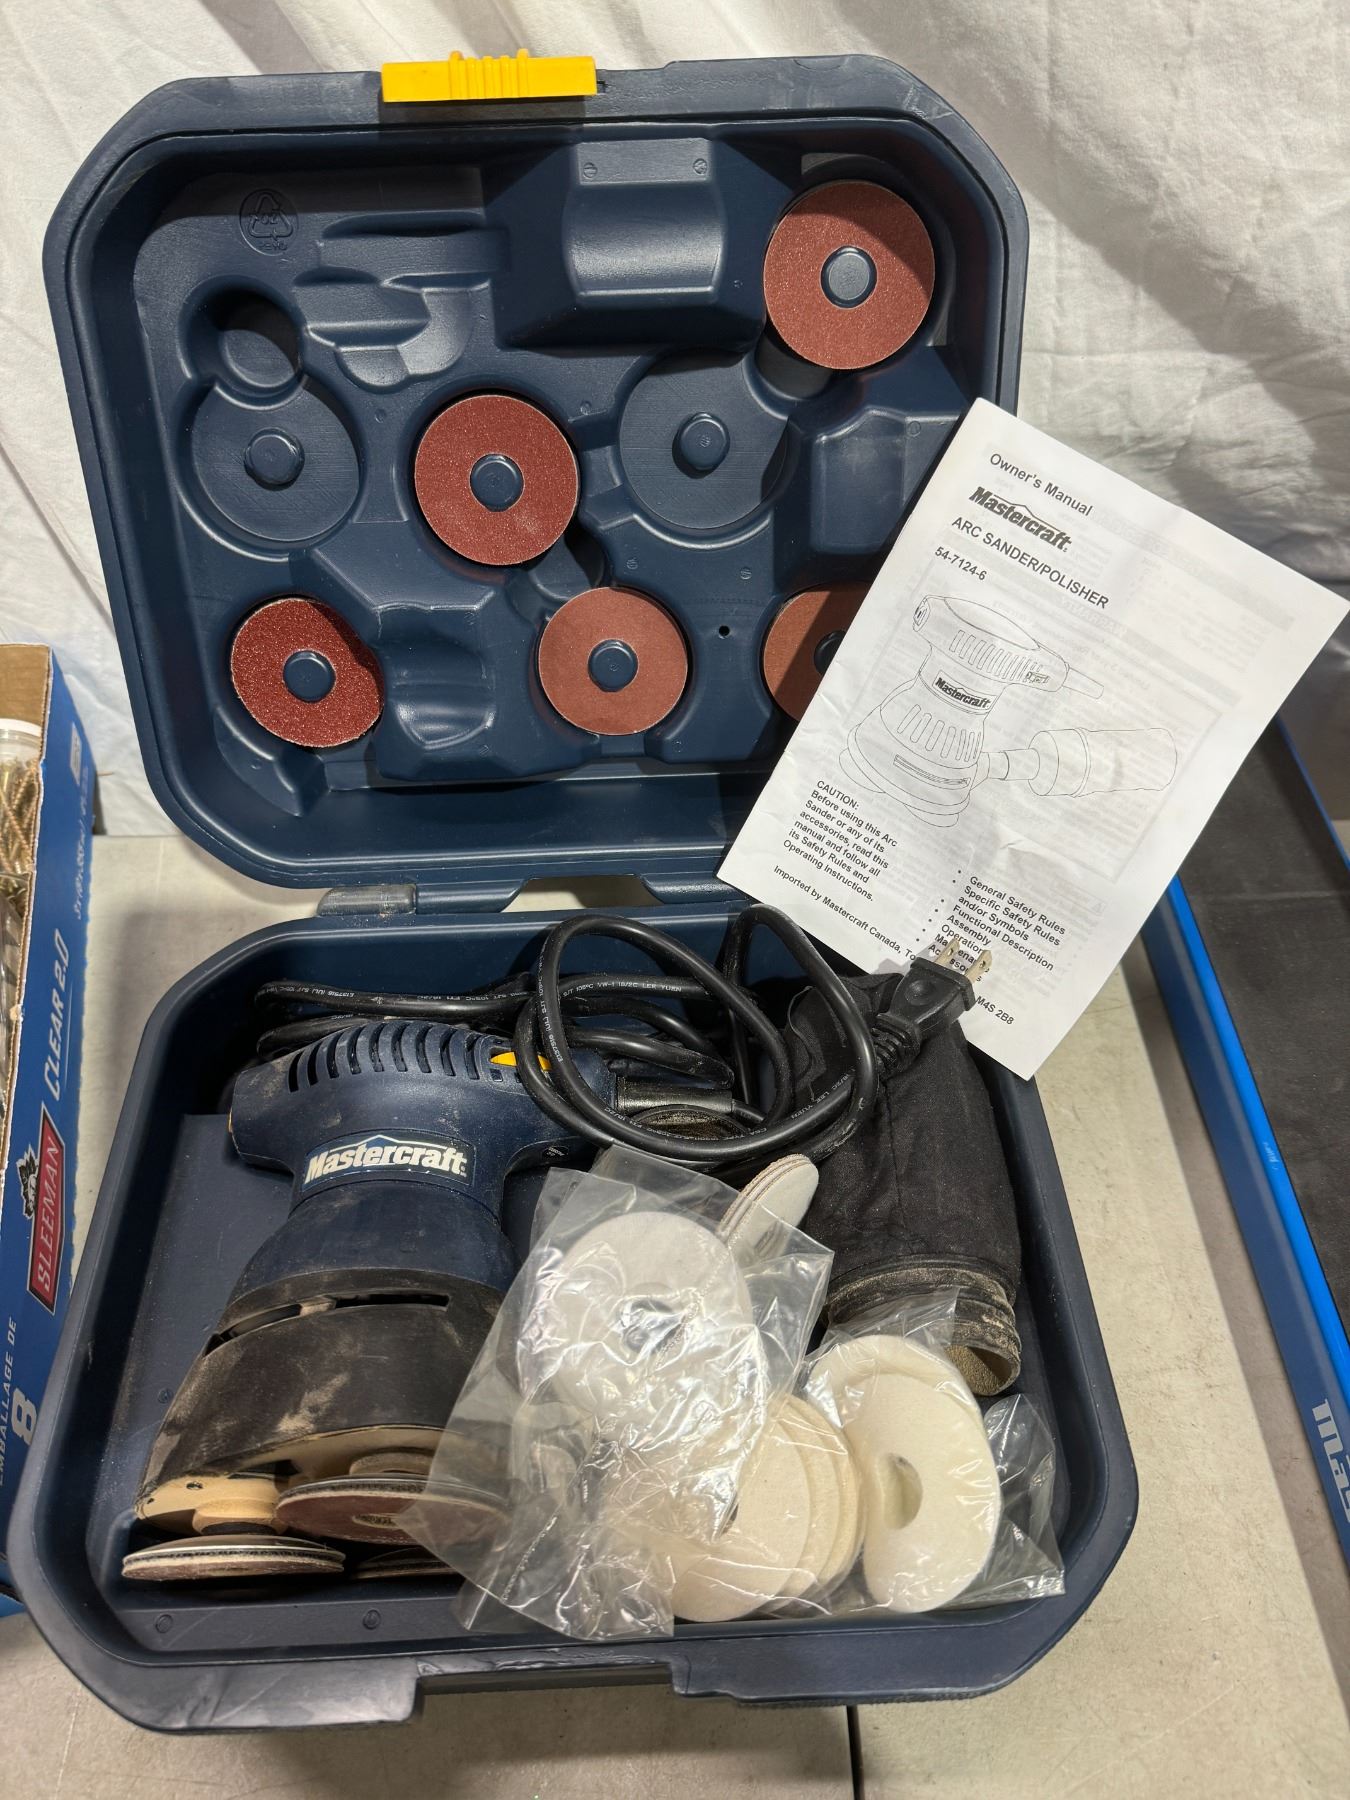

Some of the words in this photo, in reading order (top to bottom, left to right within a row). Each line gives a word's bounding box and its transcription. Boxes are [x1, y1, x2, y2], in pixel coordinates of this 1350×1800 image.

[990, 453, 1042, 488] Owner's
[1044, 482, 1094, 517] Manual
[969, 486, 1072, 551] Mastercraft
[935, 547, 987, 581] 54-7124-6
[952, 516, 982, 538] ARC
[983, 532, 1109, 608] SANDER/POLISHER
[935, 677, 991, 709] Mastercraft
[811, 790, 839, 811] Before
[840, 809, 864, 828] using
[864, 822, 881, 837] this
[882, 834, 898, 847] Arc
[817, 780, 859, 810] CAUTION:
[788, 828, 800, 840] its
[801, 836, 828, 858] Safety
[828, 853, 852, 872] Rules
[852, 870, 870, 883] and
[794, 821, 825, 843] manual
[825, 839, 843, 853] and
[842, 849, 869, 869] follow
[868, 867, 881, 877] all
[800, 810, 850, 847] accessories,
[852, 842, 873, 858] read
[872, 855, 889, 869] this
[805, 799, 836, 822] Sander
[836, 820, 847, 828] or
[847, 826, 862, 840] any
[863, 835, 874, 844] of
[873, 841, 885, 853] its
[783, 839, 824, 870] Operating
[824, 864, 874, 901] Instructions.
[947, 915, 992, 946] Assembly
[958, 896, 987, 917] and/or
[988, 913, 1030, 942] Symbols
[964, 885, 1000, 912] Specific
[1002, 907, 1032, 930] Safety
[1033, 924, 1061, 946] Rules
[970, 876, 1007, 900] General
[1007, 896, 1038, 919] Safety
[1038, 914, 1066, 936] Rules
[773, 865, 812, 893] Imported
[810, 888, 822, 901] by
[822, 896, 869, 931] Mastercraft
[869, 926, 902, 954] Canada,
[976, 995, 996, 1013] M4S
[996, 1009, 1014, 1025] 2B8
[953, 904, 1001, 938] Functional
[1001, 933, 1055, 971] Description
[44, 988, 65, 1101] CLEAR
[55, 928, 69, 993] 2.0
[304, 1143, 467, 1185] Mastercraft
[37, 1136, 59, 1292] SLEEMAN
[7, 1316, 17, 1346] DE
[11, 1387, 38, 1446] 8
